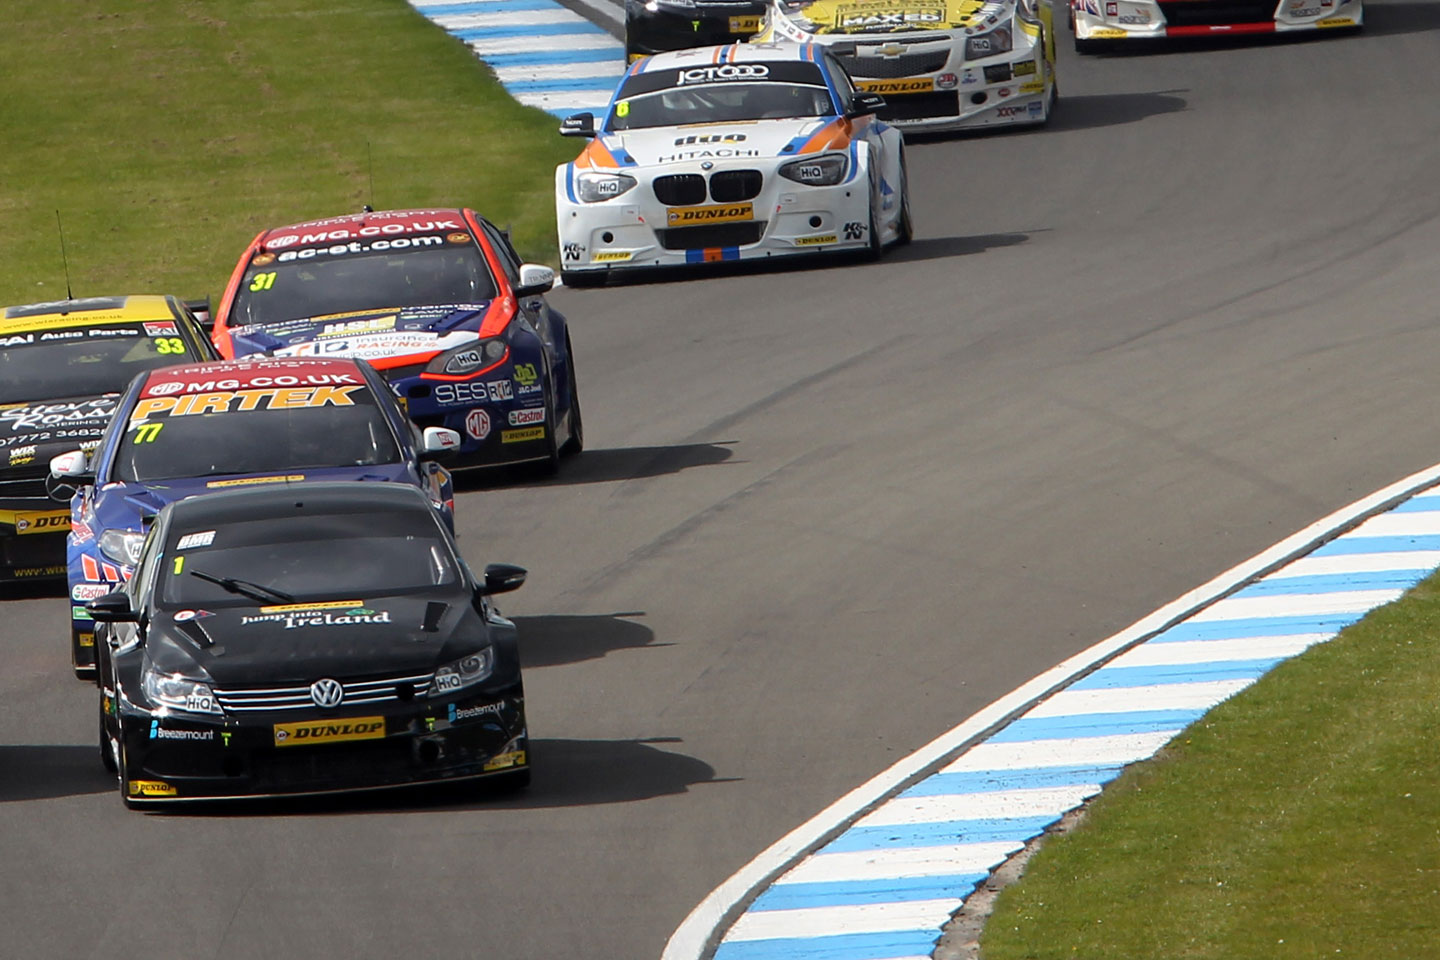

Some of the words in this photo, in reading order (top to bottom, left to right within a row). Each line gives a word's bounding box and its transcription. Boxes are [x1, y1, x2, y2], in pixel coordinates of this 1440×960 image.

[677, 64, 770, 86] JCT600
[866, 83, 933, 93] DUNLOP
[659, 149, 760, 163] HITACHI
[800, 166, 822, 178] HiQ
[599, 181, 618, 192] HiQ
[682, 205, 753, 220] DUNLOP
[300, 219, 461, 245] MG.CO.UK
[277, 234, 443, 263] ac-et.com
[249, 271, 278, 293] 31
[40, 330, 84, 341] Auto
[88, 327, 139, 338] Parts
[154, 338, 187, 355] 33
[356, 340, 421, 350] RACING
[457, 352, 480, 365] HiQ
[187, 374, 358, 393] MG.CO.UK
[435, 382, 487, 404] SES
[130, 385, 366, 422] PIRTEK
[517, 410, 544, 423] Castrol
[133, 422, 164, 445] 77
[10, 444, 38, 456] WIX
[34, 516, 73, 529] DUN
[173, 556, 185, 575] 1
[241, 615, 286, 626] Jump
[284, 611, 393, 629] Ireland
[437, 675, 460, 691] HiQ
[187, 697, 211, 710] HiQ
[158, 727, 215, 740] Breezemount
[293, 722, 384, 739] DUNLOP
